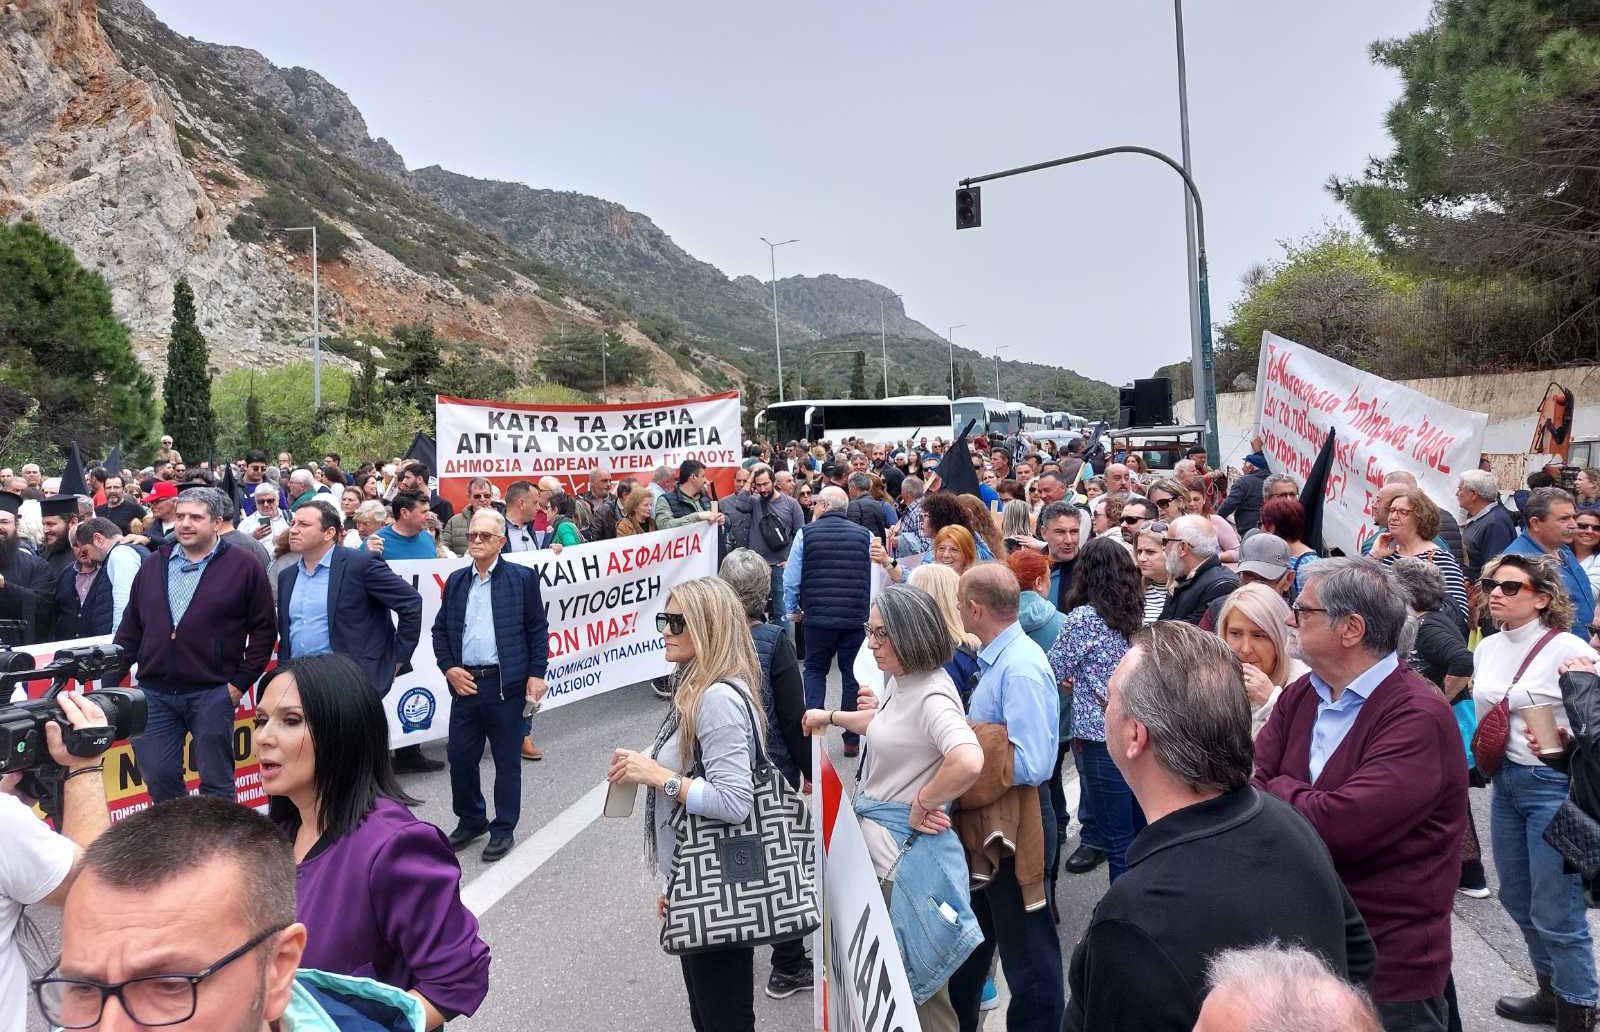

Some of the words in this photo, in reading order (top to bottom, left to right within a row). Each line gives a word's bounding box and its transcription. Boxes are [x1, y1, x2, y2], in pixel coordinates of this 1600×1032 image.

[487, 411, 558, 434] ΚΑΤΩ
[574, 416, 606, 433] ΤΑ
[622, 408, 694, 431] ΧΕΡΙΑ
[456, 433, 499, 454] ΑΠ'
[507, 434, 542, 453] ΤΑ
[557, 426, 723, 452] ΝΟΣΟΚΟΜΕΙΑ
[444, 457, 522, 474] ΔΗΜΟΣΙΑ
[532, 456, 599, 472] ΔΩΡΕΑΝ
[609, 453, 654, 469] ΥΓΕΙΑ
[582, 555, 600, 580] Η
[606, 533, 702, 574] ΑΣΦΑΛΕΙΑ
[559, 575, 662, 622] ΥΠΟΘΕΣΗ
[547, 627, 580, 660] ΩΝ
[586, 611, 640, 648] ΜΑΣ!
[546, 653, 600, 682] ΝΟΜΙΚΩΝ
[603, 636, 666, 664] ΥΠΑΛΛΗΛΩ
[547, 670, 602, 700] ΛΑΣΙΘΙΟΥ
[93, 736, 108, 746] JVC
[237, 786, 266, 803] ΝΗΠΙΑ
